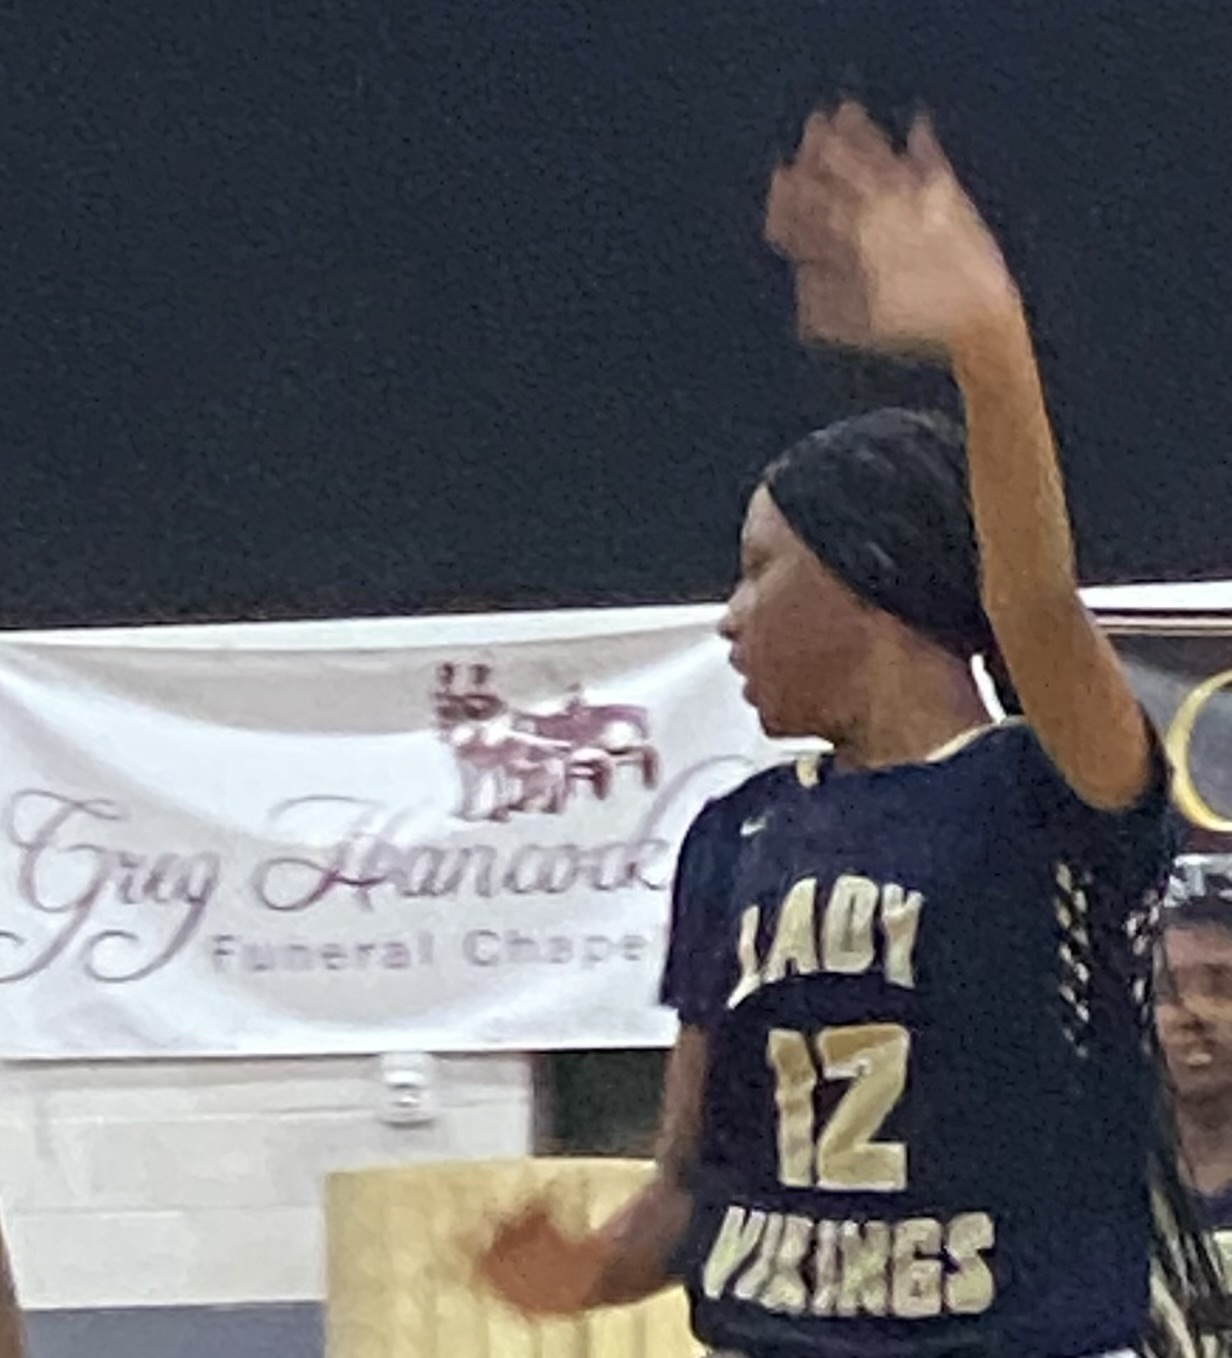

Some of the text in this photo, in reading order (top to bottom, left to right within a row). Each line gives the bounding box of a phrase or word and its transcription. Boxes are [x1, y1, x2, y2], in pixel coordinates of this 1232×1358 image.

[211, 927, 666, 972] Funeral Chape
[725, 873, 926, 1010] LADY
[767, 1021, 911, 1193] 12
[702, 1204, 997, 1319] VIKINGS
